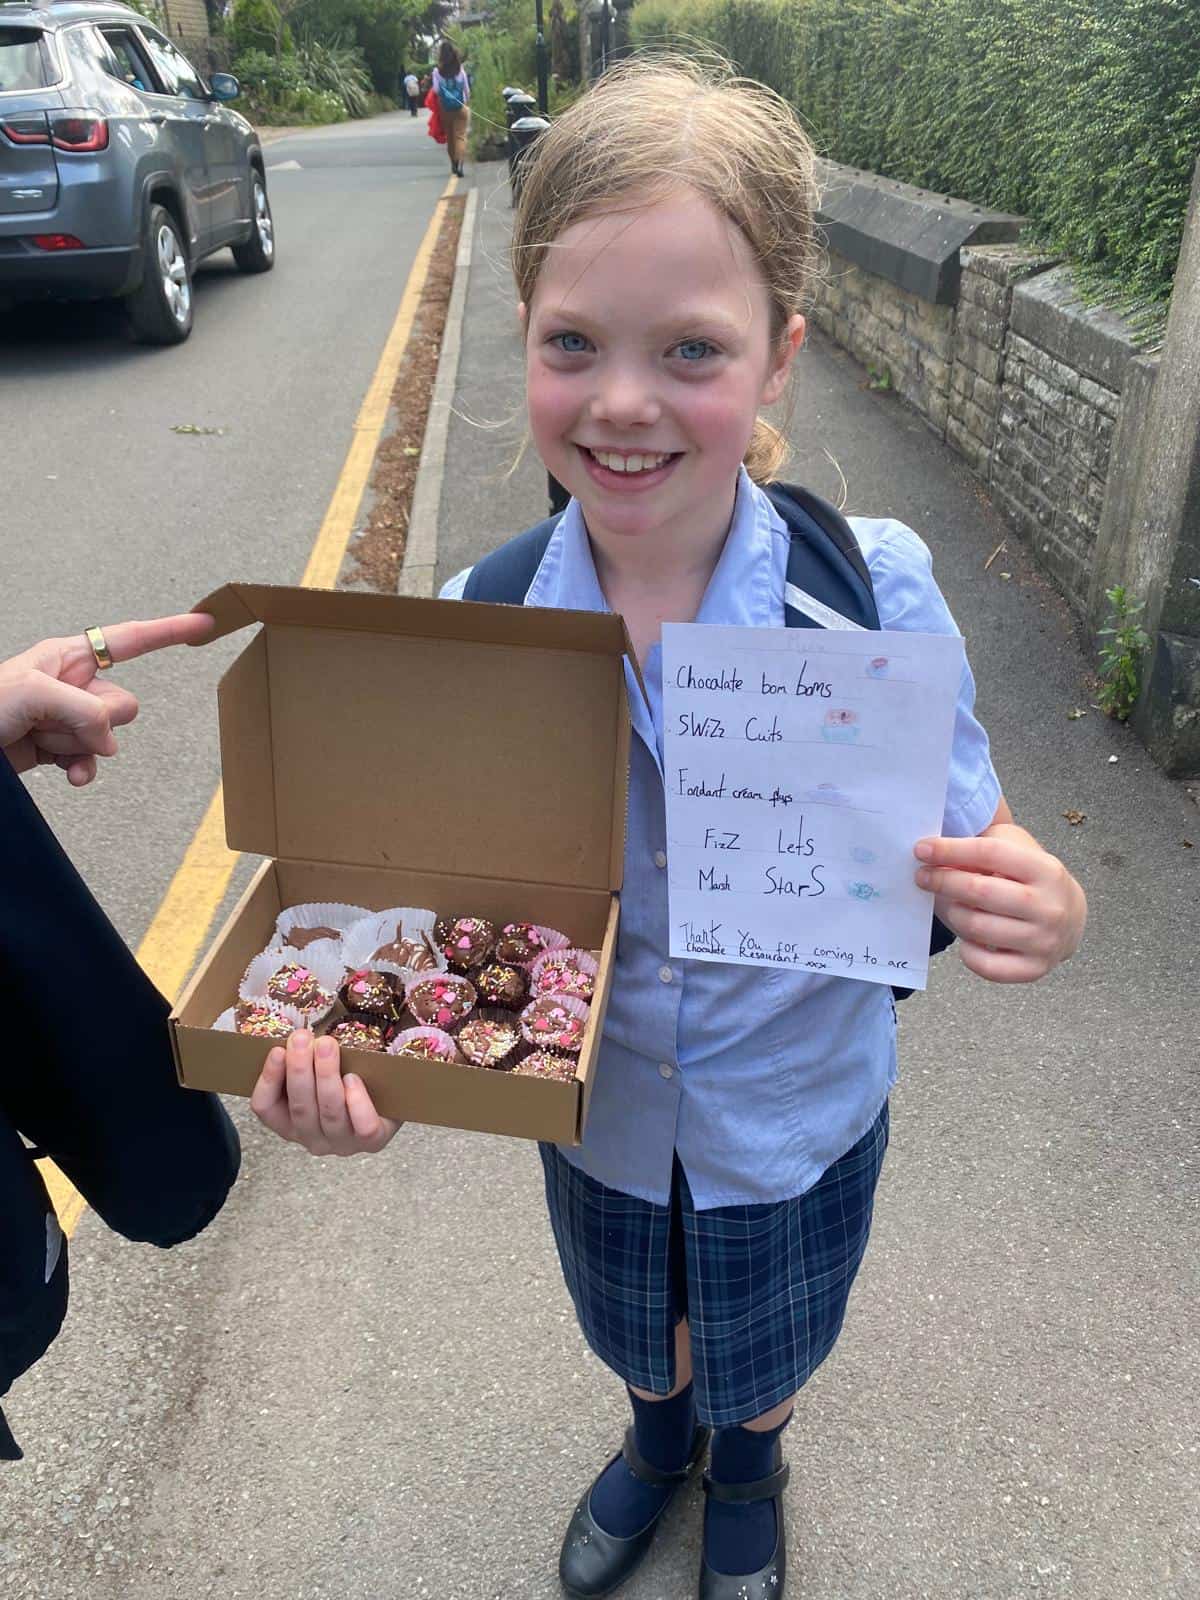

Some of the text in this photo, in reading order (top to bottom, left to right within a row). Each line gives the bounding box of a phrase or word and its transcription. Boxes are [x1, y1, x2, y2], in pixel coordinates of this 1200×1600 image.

[732, 787, 763, 800] cream
[776, 940, 799, 953] for
[813, 946, 855, 968] coming
[863, 945, 878, 965] to
[887, 960, 909, 969] are
